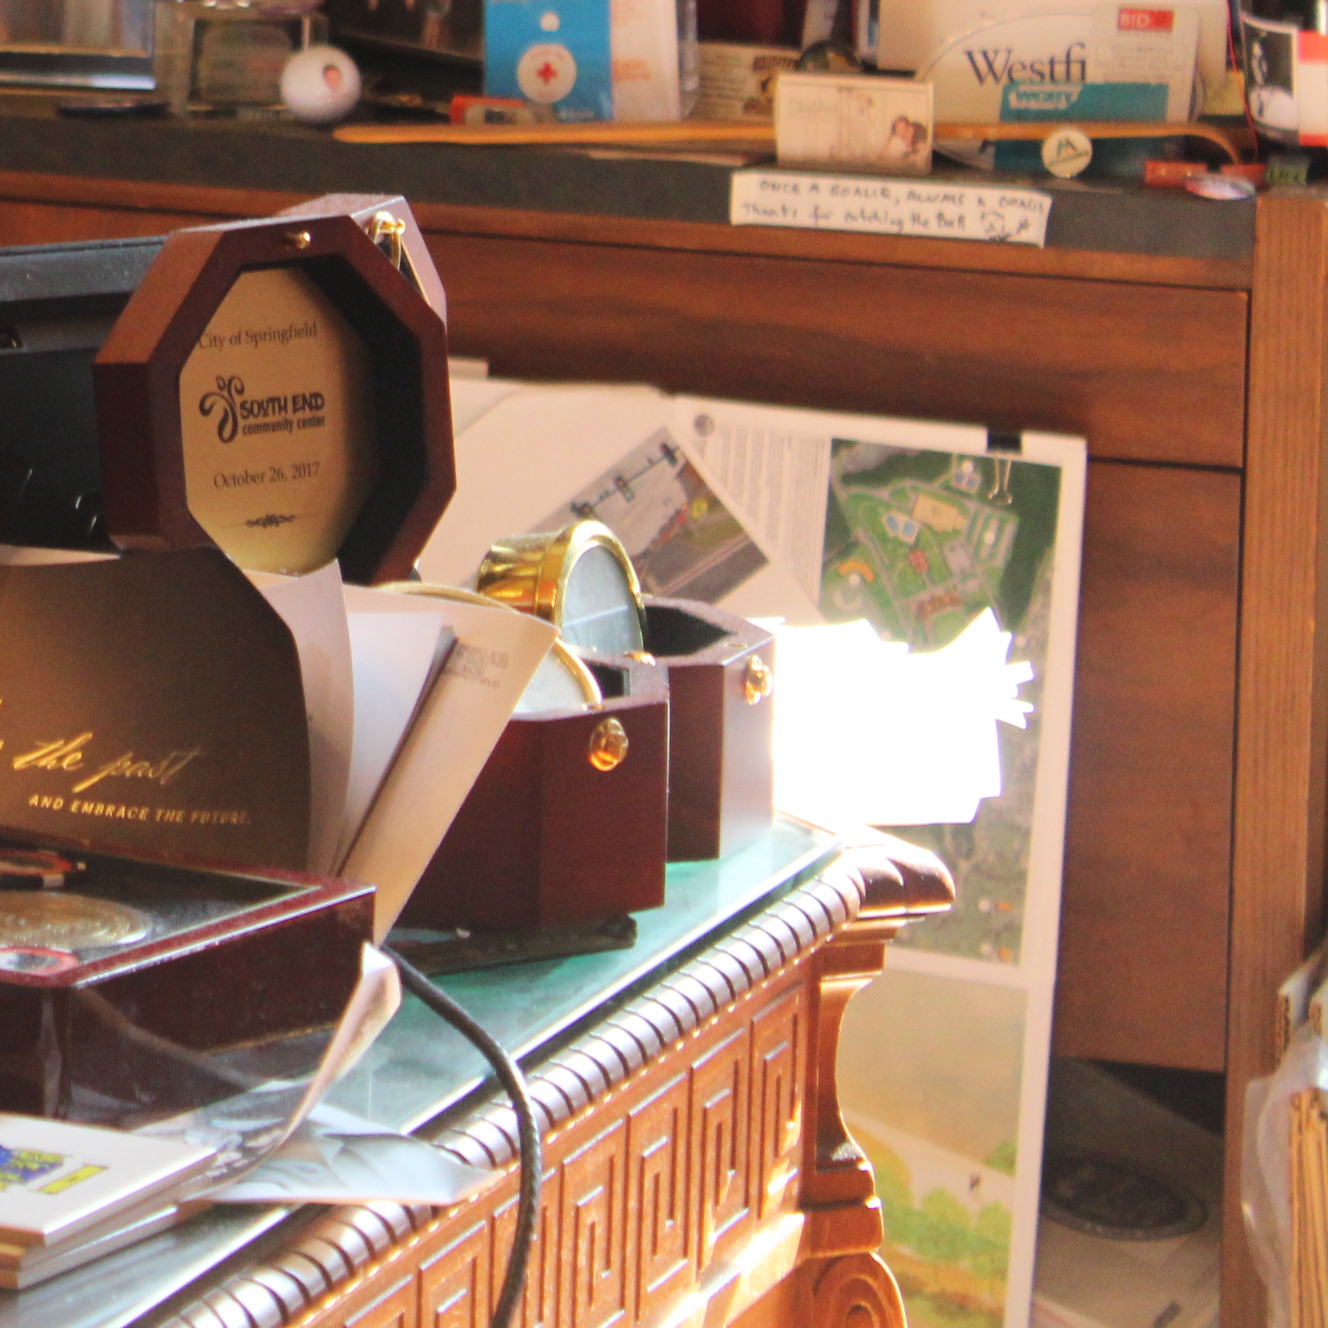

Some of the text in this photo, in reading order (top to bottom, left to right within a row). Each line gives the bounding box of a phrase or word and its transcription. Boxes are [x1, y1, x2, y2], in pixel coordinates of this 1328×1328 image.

[964, 41, 1088, 87] Westfi
[759, 178, 800, 196] ONCE
[808, 180, 821, 195] A
[199, 322, 318, 353] City of Springfield
[239, 391, 325, 421] SOUTH END
[241, 415, 326, 437] community center
[213, 469, 265, 490] October
[291, 461, 321, 480] 2017
[12, 731, 93, 771] the
[28, 793, 65, 811] AND
[70, 800, 149, 822] EMBRACE
[155, 808, 186, 823] THE
